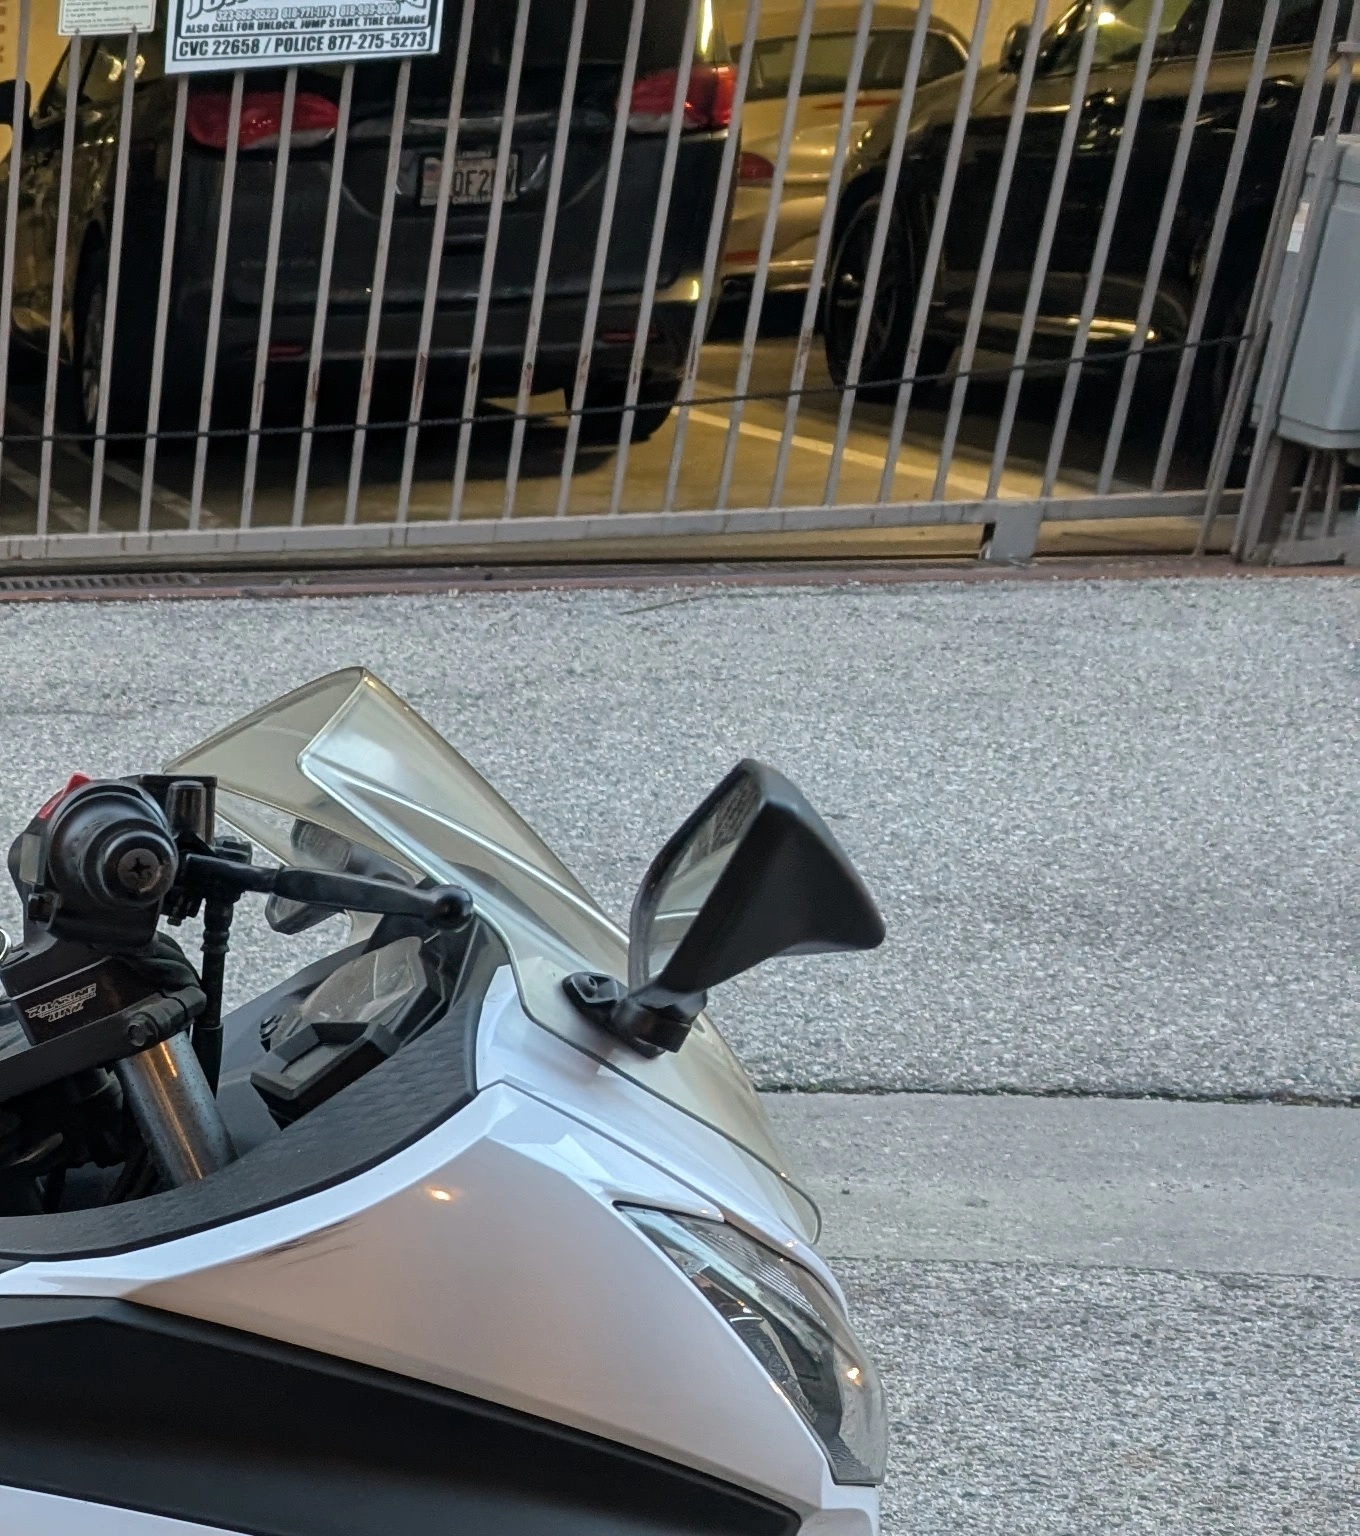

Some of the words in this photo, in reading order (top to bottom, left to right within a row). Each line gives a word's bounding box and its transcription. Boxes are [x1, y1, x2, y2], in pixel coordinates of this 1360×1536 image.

[185, 23, 209, 34] ALSO
[211, 22, 234, 32] CALL
[237, 21, 255, 31] FOR
[300, 19, 326, 29] JUMP
[363, 16, 384, 26] TIRE
[386, 15, 426, 25] CHANGE
[179, 40, 209, 56] CVC
[212, 38, 261, 55] 22658
[274, 36, 325, 53] POLICE
[327, 31, 428, 51] 877-275-5273
